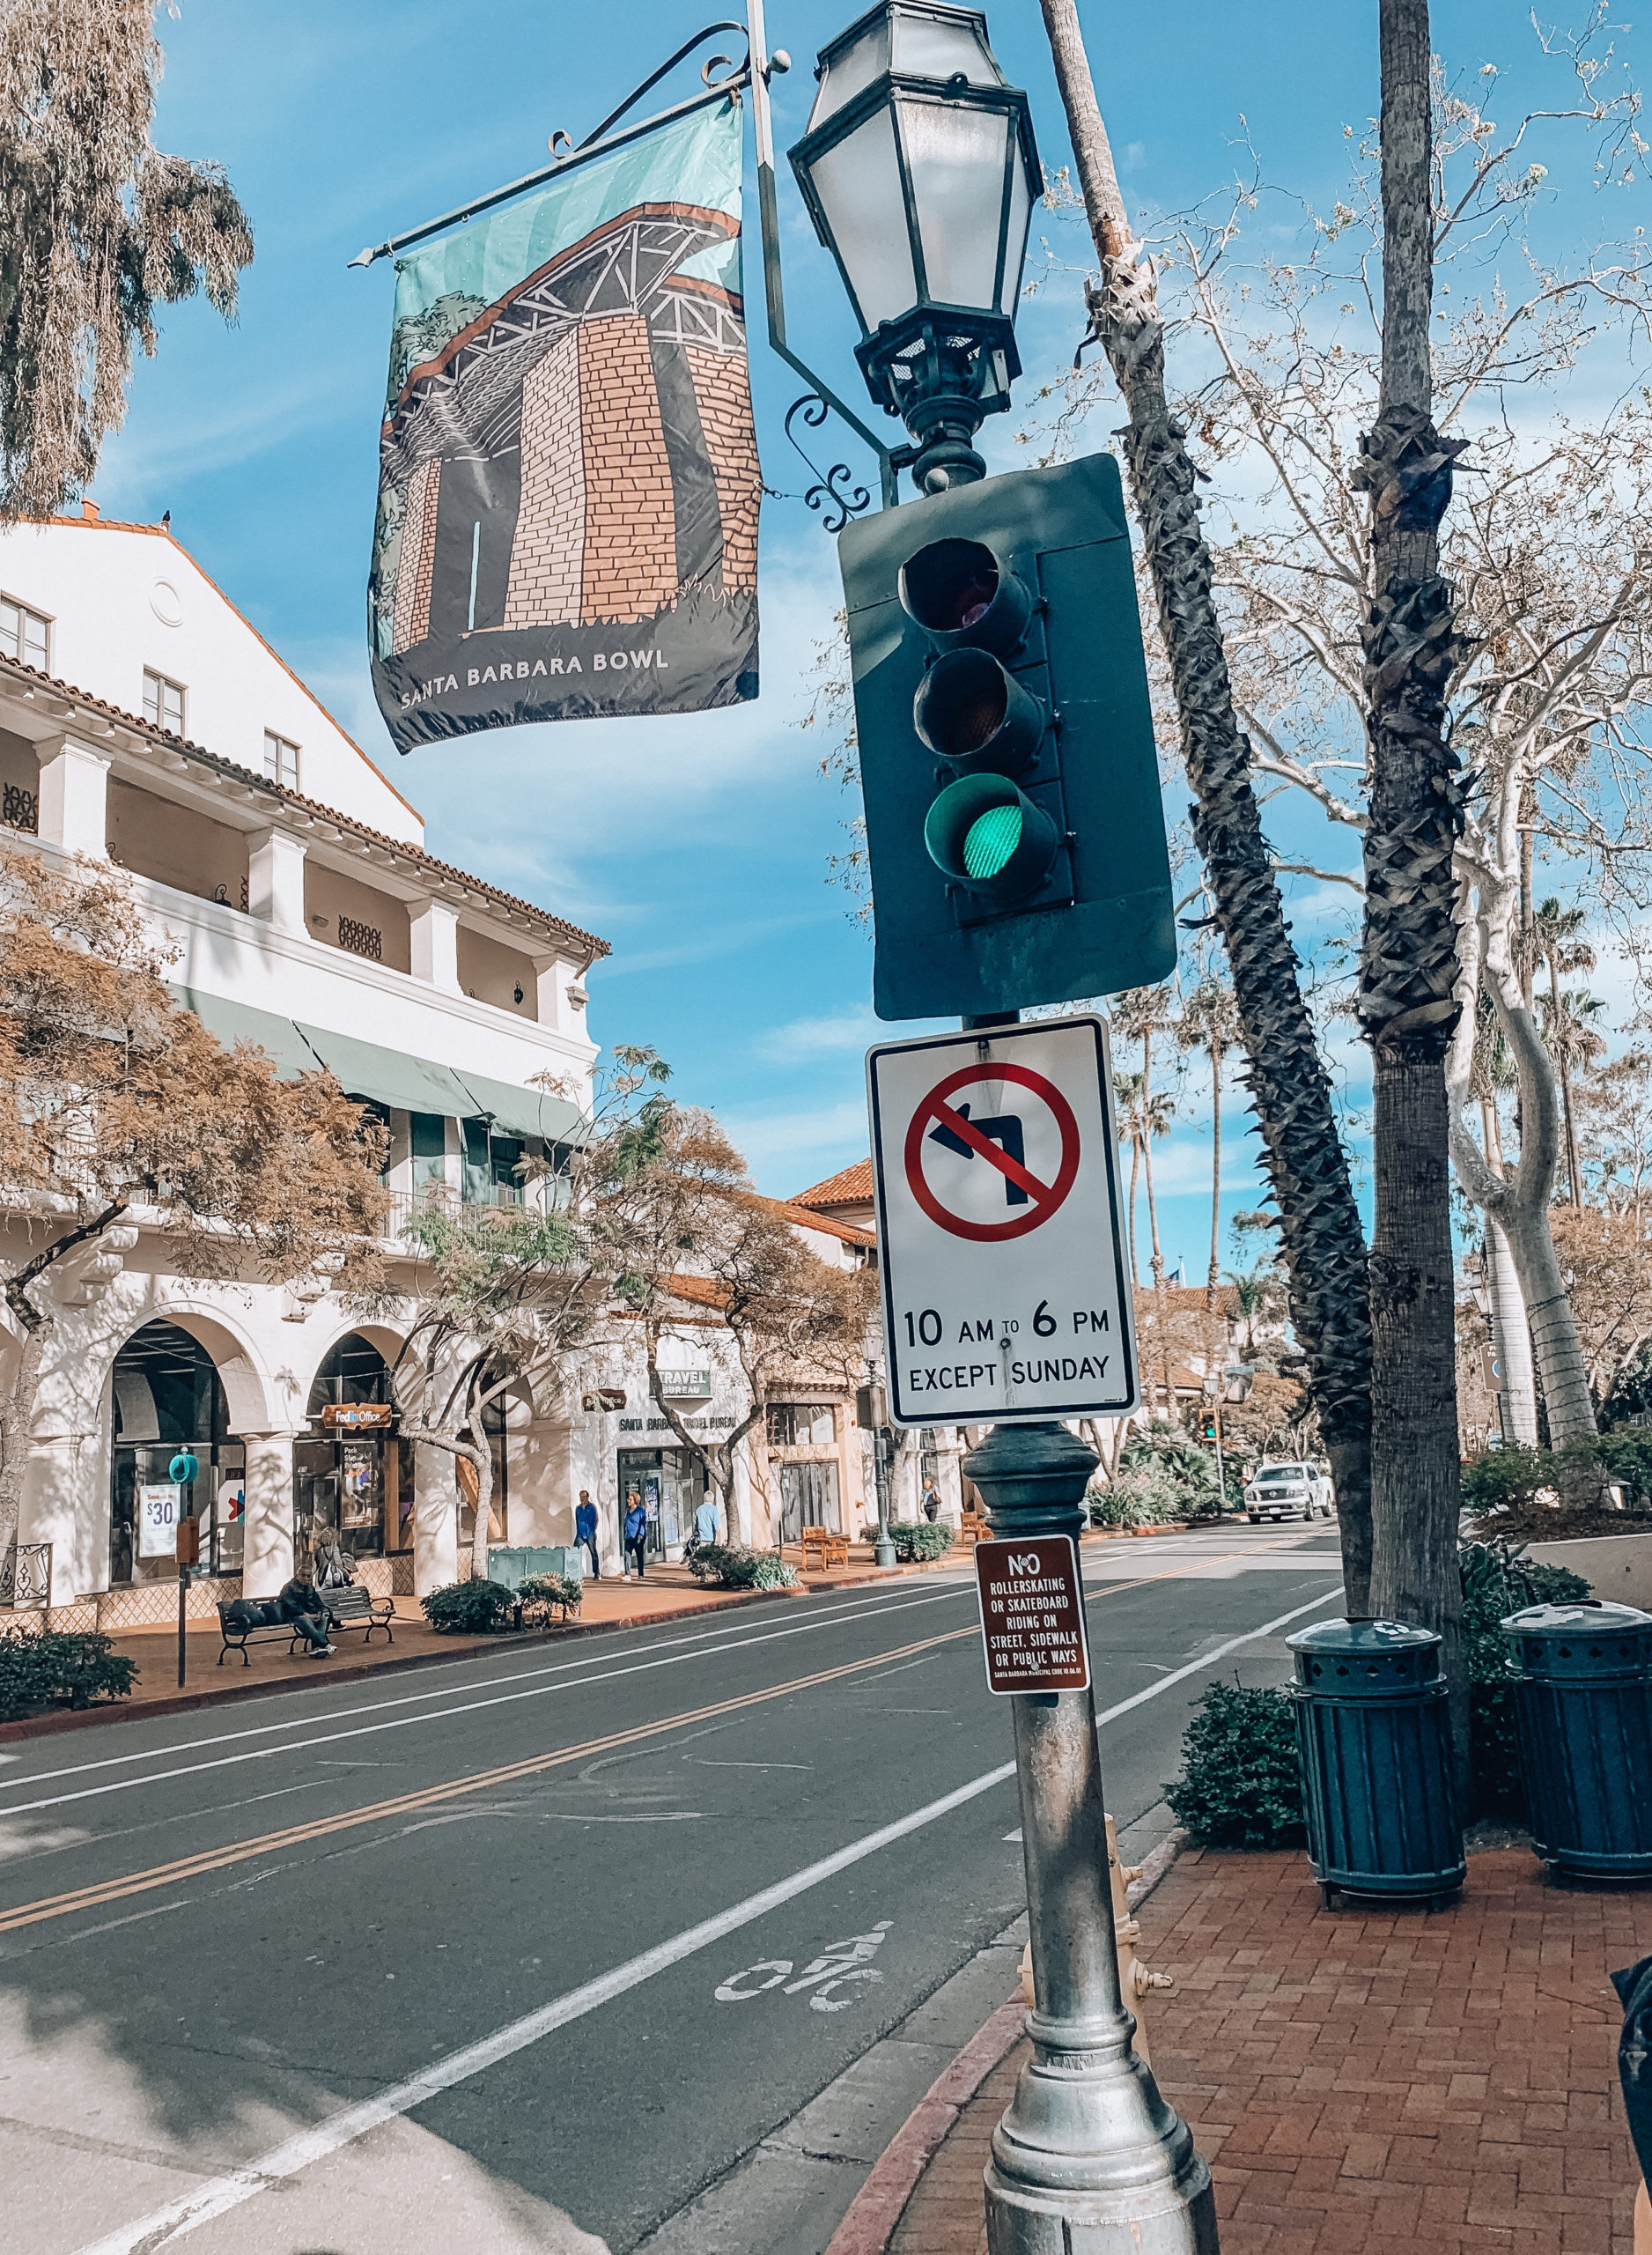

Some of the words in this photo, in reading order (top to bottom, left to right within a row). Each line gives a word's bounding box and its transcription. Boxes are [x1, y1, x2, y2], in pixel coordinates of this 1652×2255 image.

[401, 673, 460, 711] SANTA
[467, 655, 583, 687] BARBARA
[594, 649, 669, 672] BOWL
[904, 1308, 943, 1347] 10
[958, 1319, 994, 1343] AM
[1002, 1320, 1020, 1334] TO
[1032, 1299, 1058, 1337] 6
[1073, 1309, 1110, 1335] PM
[660, 1371, 707, 1385] TRAVEL
[910, 1364, 998, 1392] EXCEPT
[1011, 1355, 1110, 1385] SUNDAY
[663, 1386, 701, 1394] BUREAU
[619, 1418, 643, 1431] SANTA
[710, 1416, 736, 1429] BUREAU
[147, 1502, 173, 1525] $30
[1007, 1553, 1041, 1577] NO
[990, 1577, 1066, 1596] ROLLERSKATING
[991, 1600, 1005, 1614] OR
[1007, 1595, 1069, 1612] SKATEBOARD
[1006, 1615, 1040, 1630] RIDING
[1044, 1614, 1058, 1628] ON
[990, 1634, 1027, 1649] STREET,
[1029, 1630, 1079, 1647] SIDEWALK
[995, 1652, 1009, 1667] OR
[1013, 1651, 1048, 1667] PUBLIC
[1051, 1648, 1078, 1664] WAYS
[1008, 1669, 1028, 1678] BARBARA
[1029, 1667, 1051, 1676] MUNICIPAL
